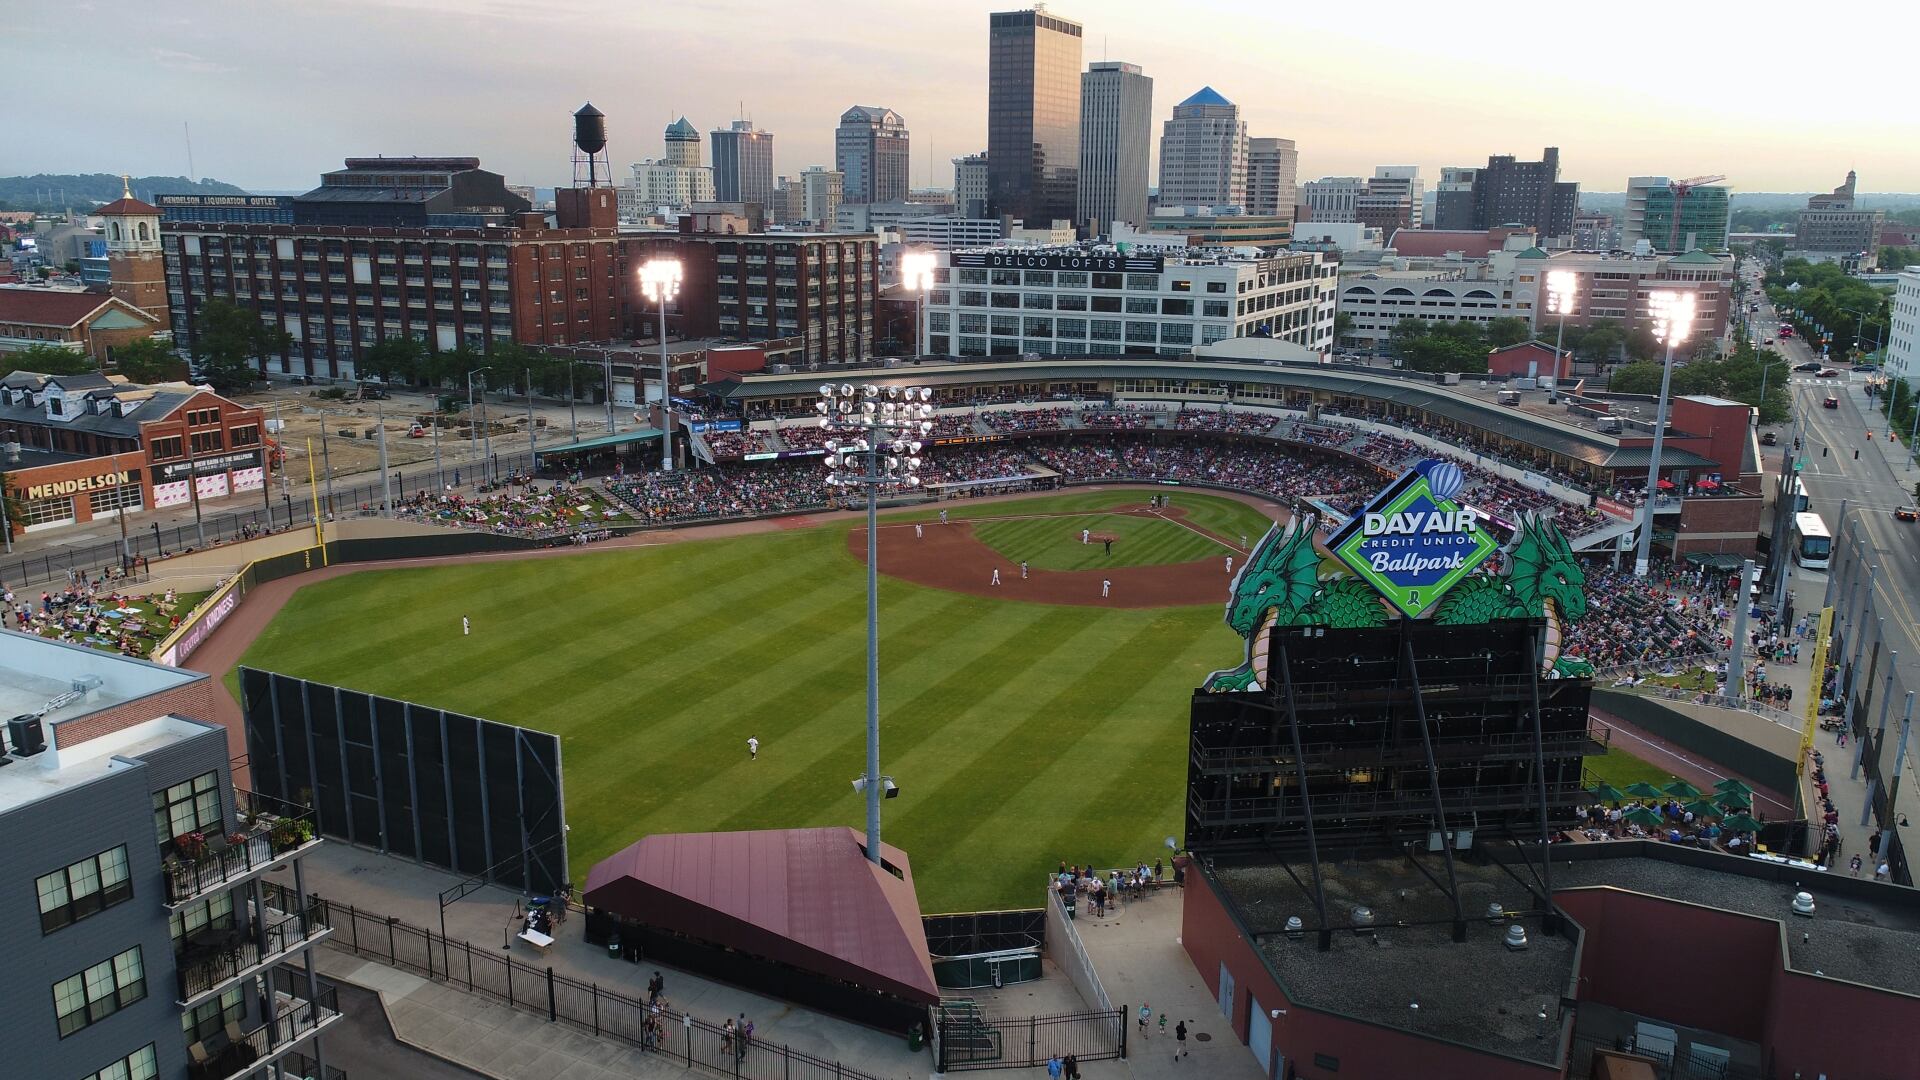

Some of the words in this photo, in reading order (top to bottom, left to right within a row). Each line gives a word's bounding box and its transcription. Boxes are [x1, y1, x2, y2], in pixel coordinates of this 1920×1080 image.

[162, 196, 200, 204] MENDELSON
[204, 197, 246, 205] LIQUIDATION
[250, 197, 277, 206] OUTLET
[994, 256, 1048, 267] DELCO
[1060, 258, 1116, 269] LOFTS
[28, 471, 129, 500] MENDELSON
[1363, 511, 1425, 536] DAY
[1422, 510, 1477, 533] AIR
[1361, 538, 1415, 548] CREDIT
[1423, 536, 1477, 546] UNION
[1370, 551, 1465, 576] Ballpark
[205, 593, 234, 630] KINDNESS
